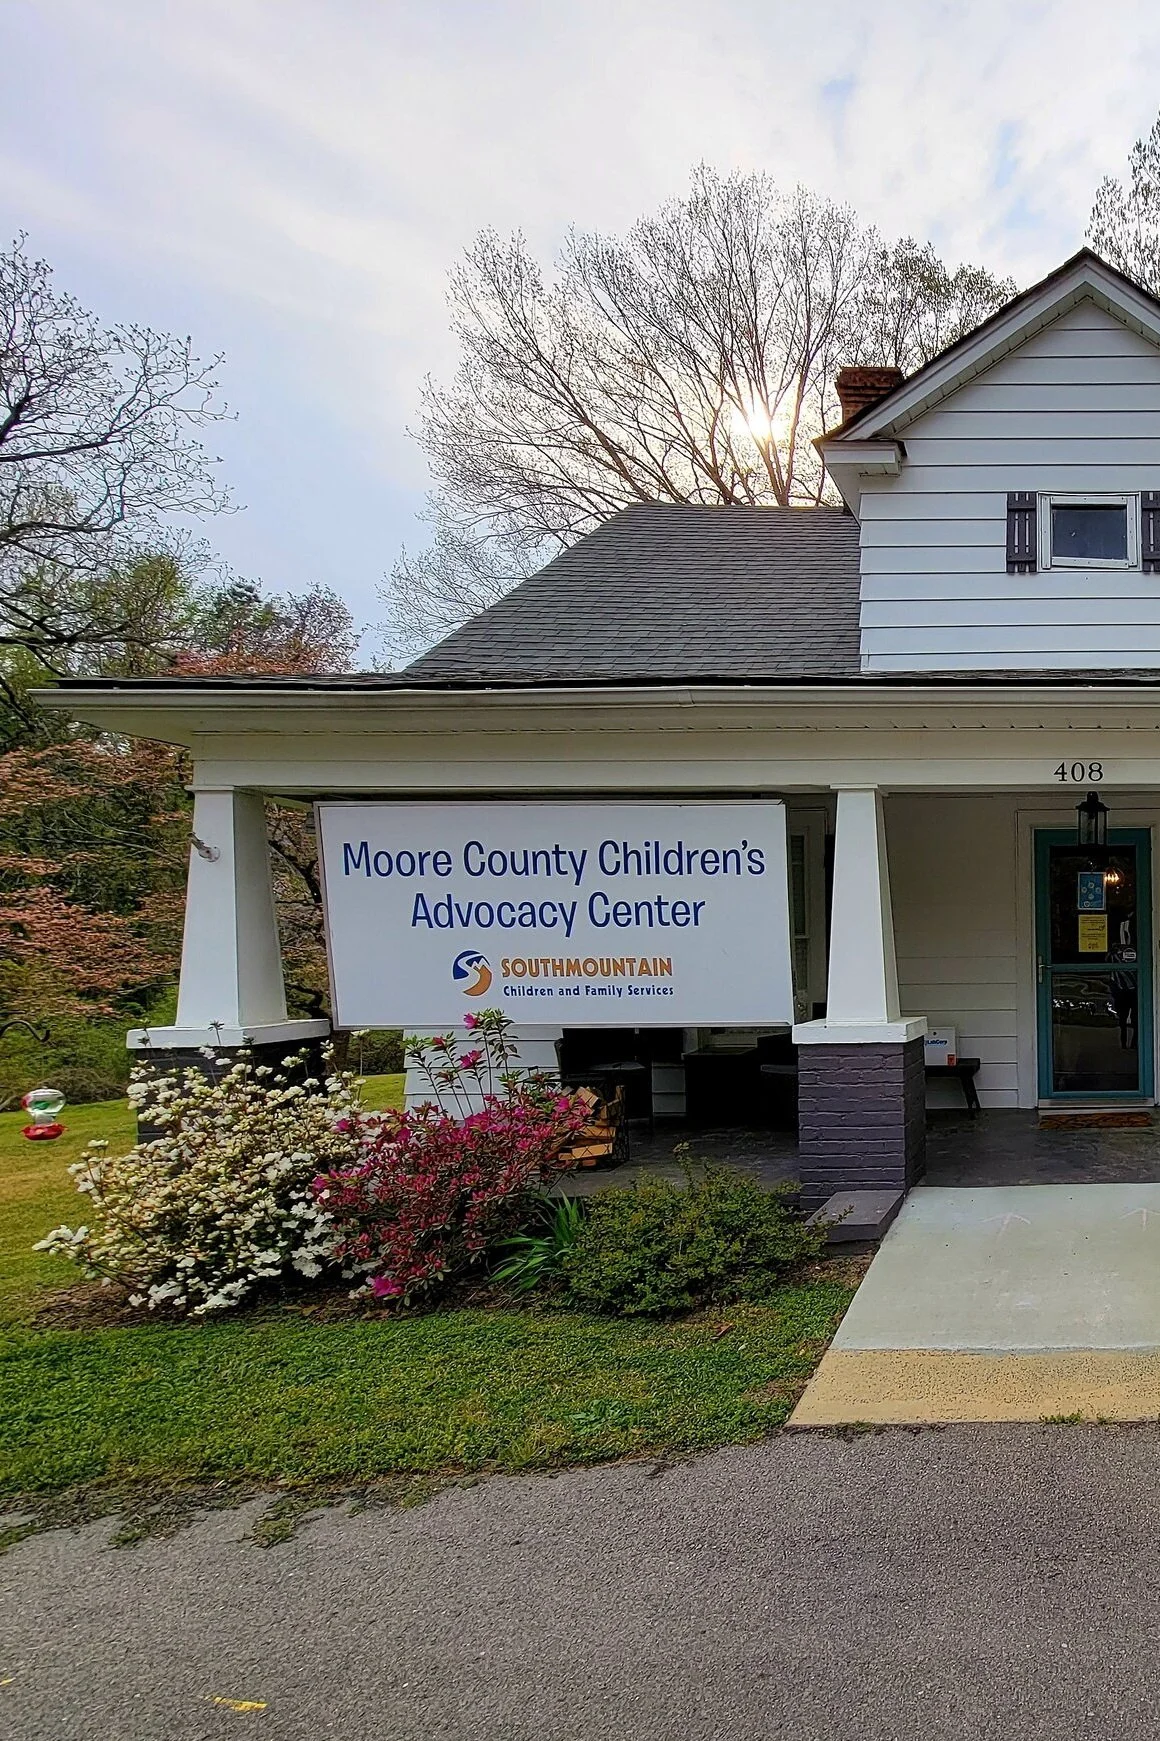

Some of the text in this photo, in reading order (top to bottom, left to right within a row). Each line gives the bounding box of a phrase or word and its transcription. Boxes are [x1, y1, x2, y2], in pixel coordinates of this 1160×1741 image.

[1053, 761, 1104, 782] 408
[343, 839, 765, 886] Moore County Children's
[411, 891, 706, 938] Advocacy Center
[501, 957, 673, 978] SOUTHMOUNTAIN
[503, 984, 674, 998] Children and Family Services
